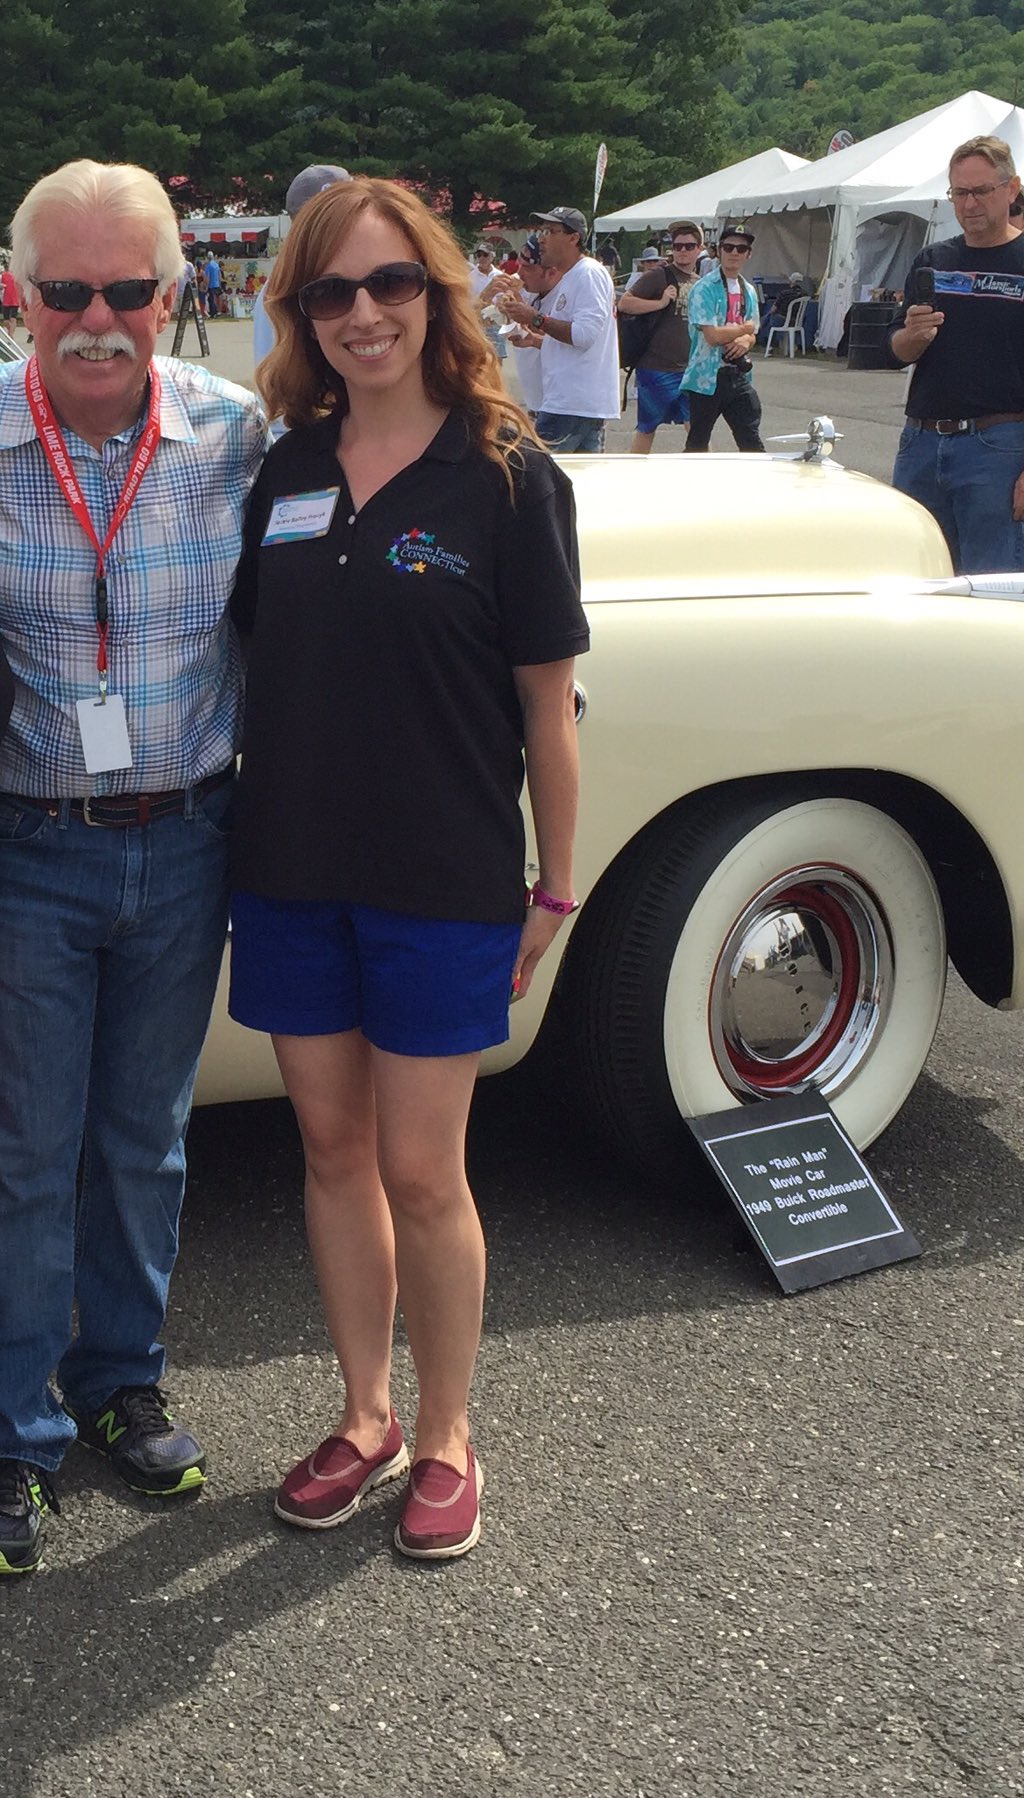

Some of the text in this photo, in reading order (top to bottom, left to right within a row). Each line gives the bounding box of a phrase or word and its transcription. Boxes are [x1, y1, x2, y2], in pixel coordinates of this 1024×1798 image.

[29, 375, 40, 390] TO
[32, 388, 44, 403] GO
[42, 425, 59, 451] LIME
[52, 451, 70, 477] ROCK
[124, 475, 139, 503] ROAD
[134, 459, 145, 475] TO
[140, 446, 150, 462] GO
[63, 477, 82, 505] PARK
[403, 541, 470, 567] Autism Families
[744, 1147, 828, 1177] The "Rain Man"
[768, 1169, 827, 1191] Movie Car
[745, 1177, 870, 1217] 1949 Buick Roadmaster
[788, 1202, 849, 1226] Convertible
